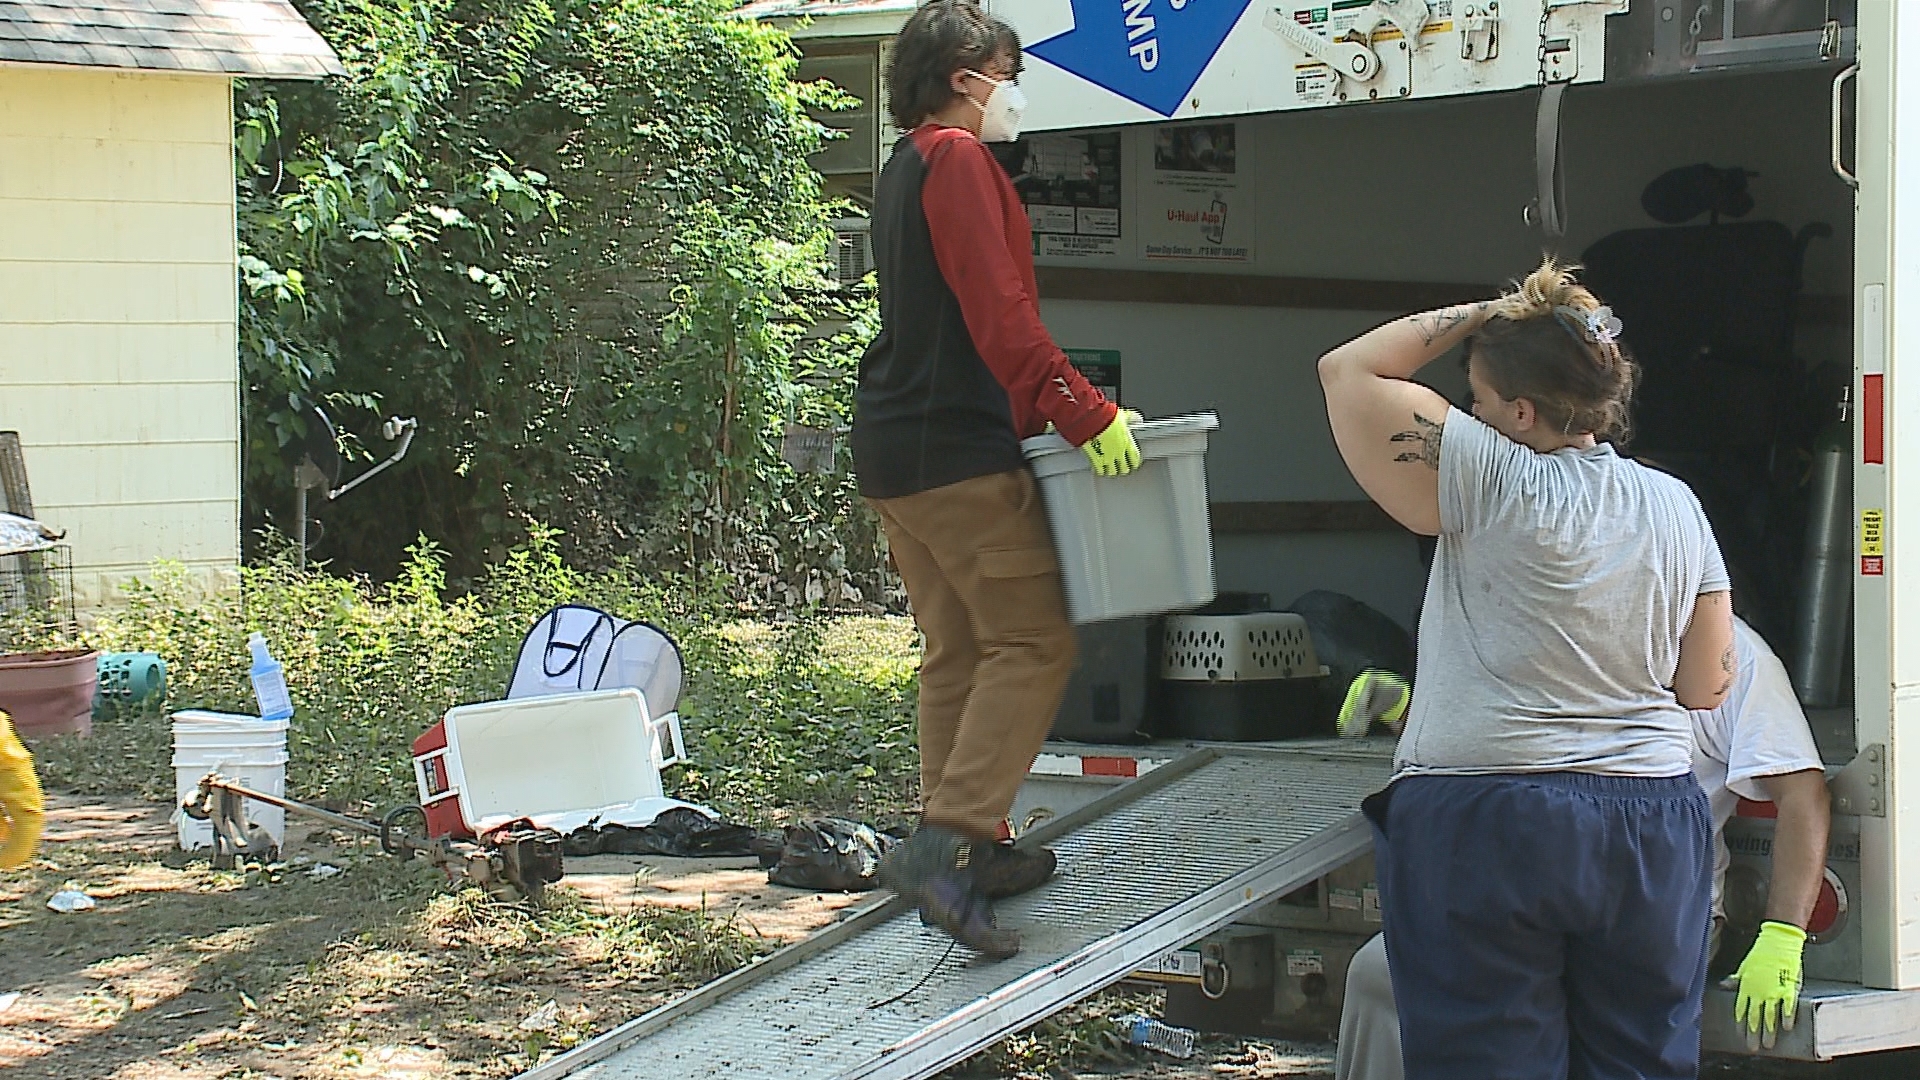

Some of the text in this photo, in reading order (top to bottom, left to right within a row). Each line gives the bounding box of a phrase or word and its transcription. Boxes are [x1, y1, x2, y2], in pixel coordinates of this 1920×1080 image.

[1121, 0, 1159, 71] MP
[1167, 209, 1220, 224] U-Haul App
[1726, 833, 1772, 857] oving
